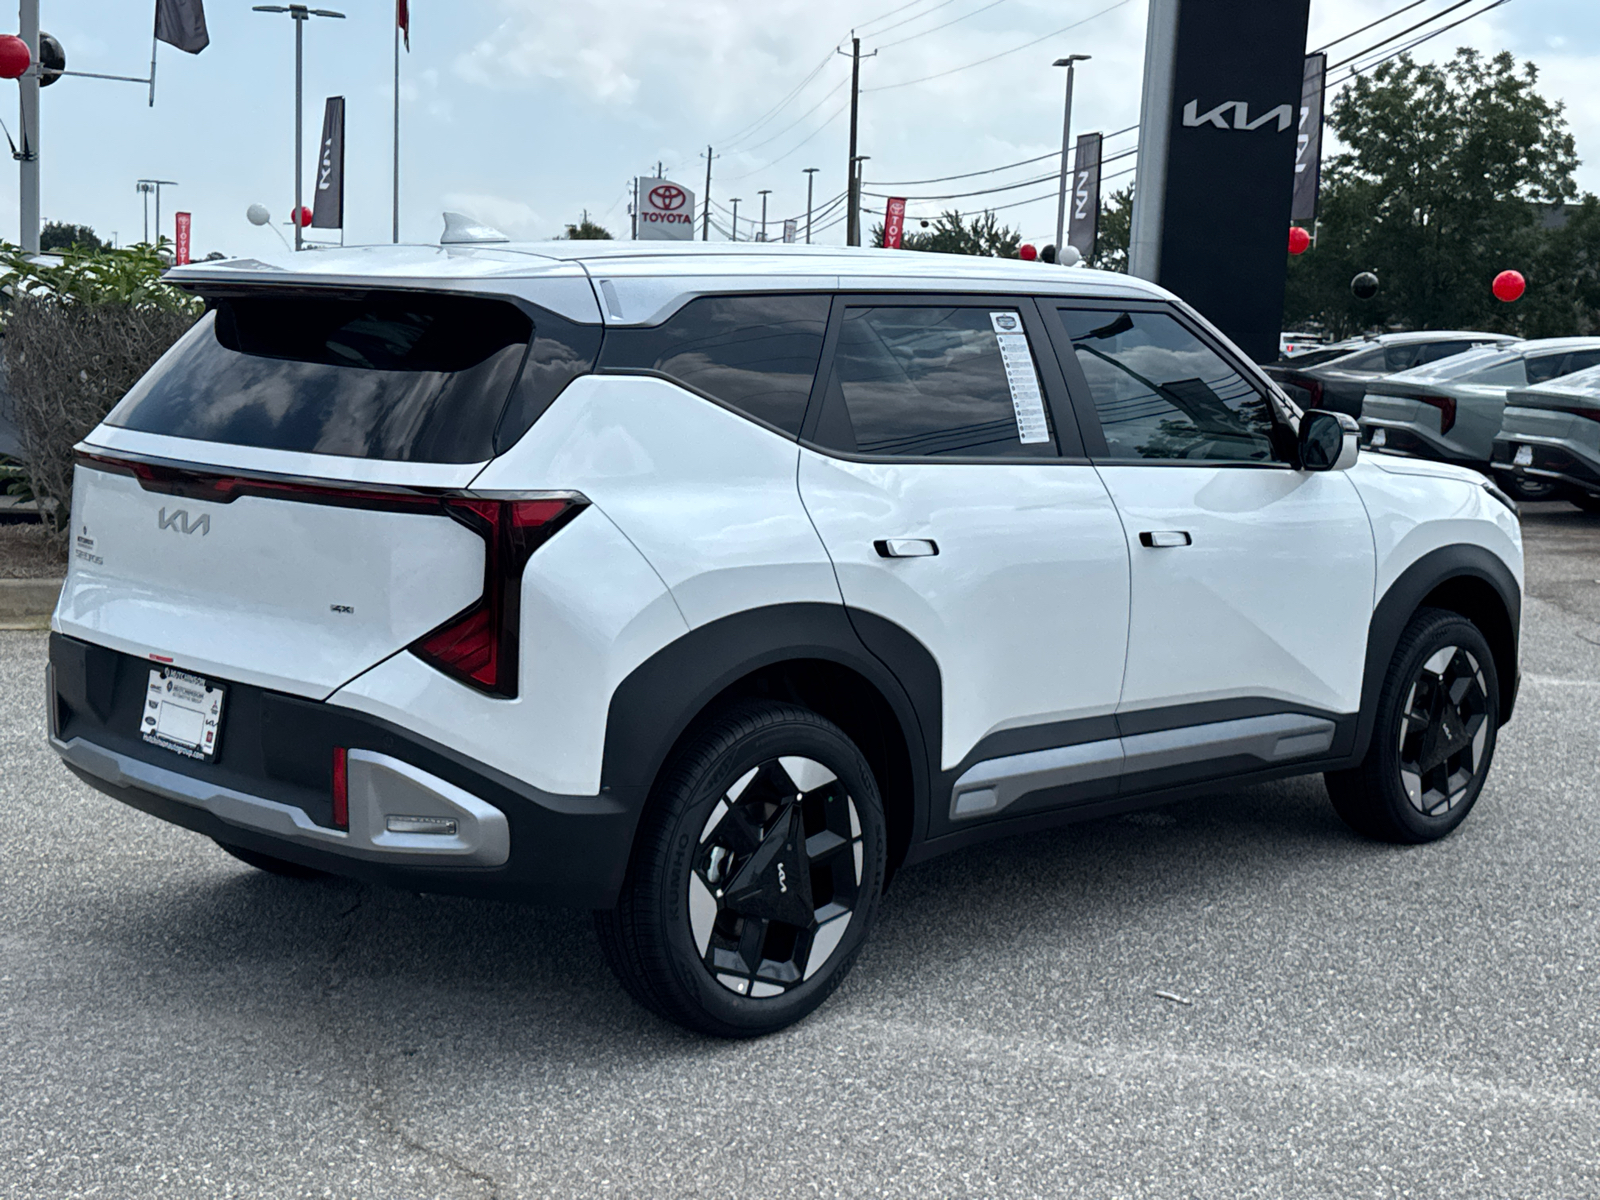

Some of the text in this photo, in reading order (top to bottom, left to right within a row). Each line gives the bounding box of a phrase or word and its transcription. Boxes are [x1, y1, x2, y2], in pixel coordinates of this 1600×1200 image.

[1182, 99, 1293, 132] KIA
[1075, 171, 1089, 219] KIA
[641, 211, 692, 225] TOYOTA
[889, 215, 900, 249] TOY
[158, 507, 210, 536] KIA
[668, 833, 689, 922] KUMHO
